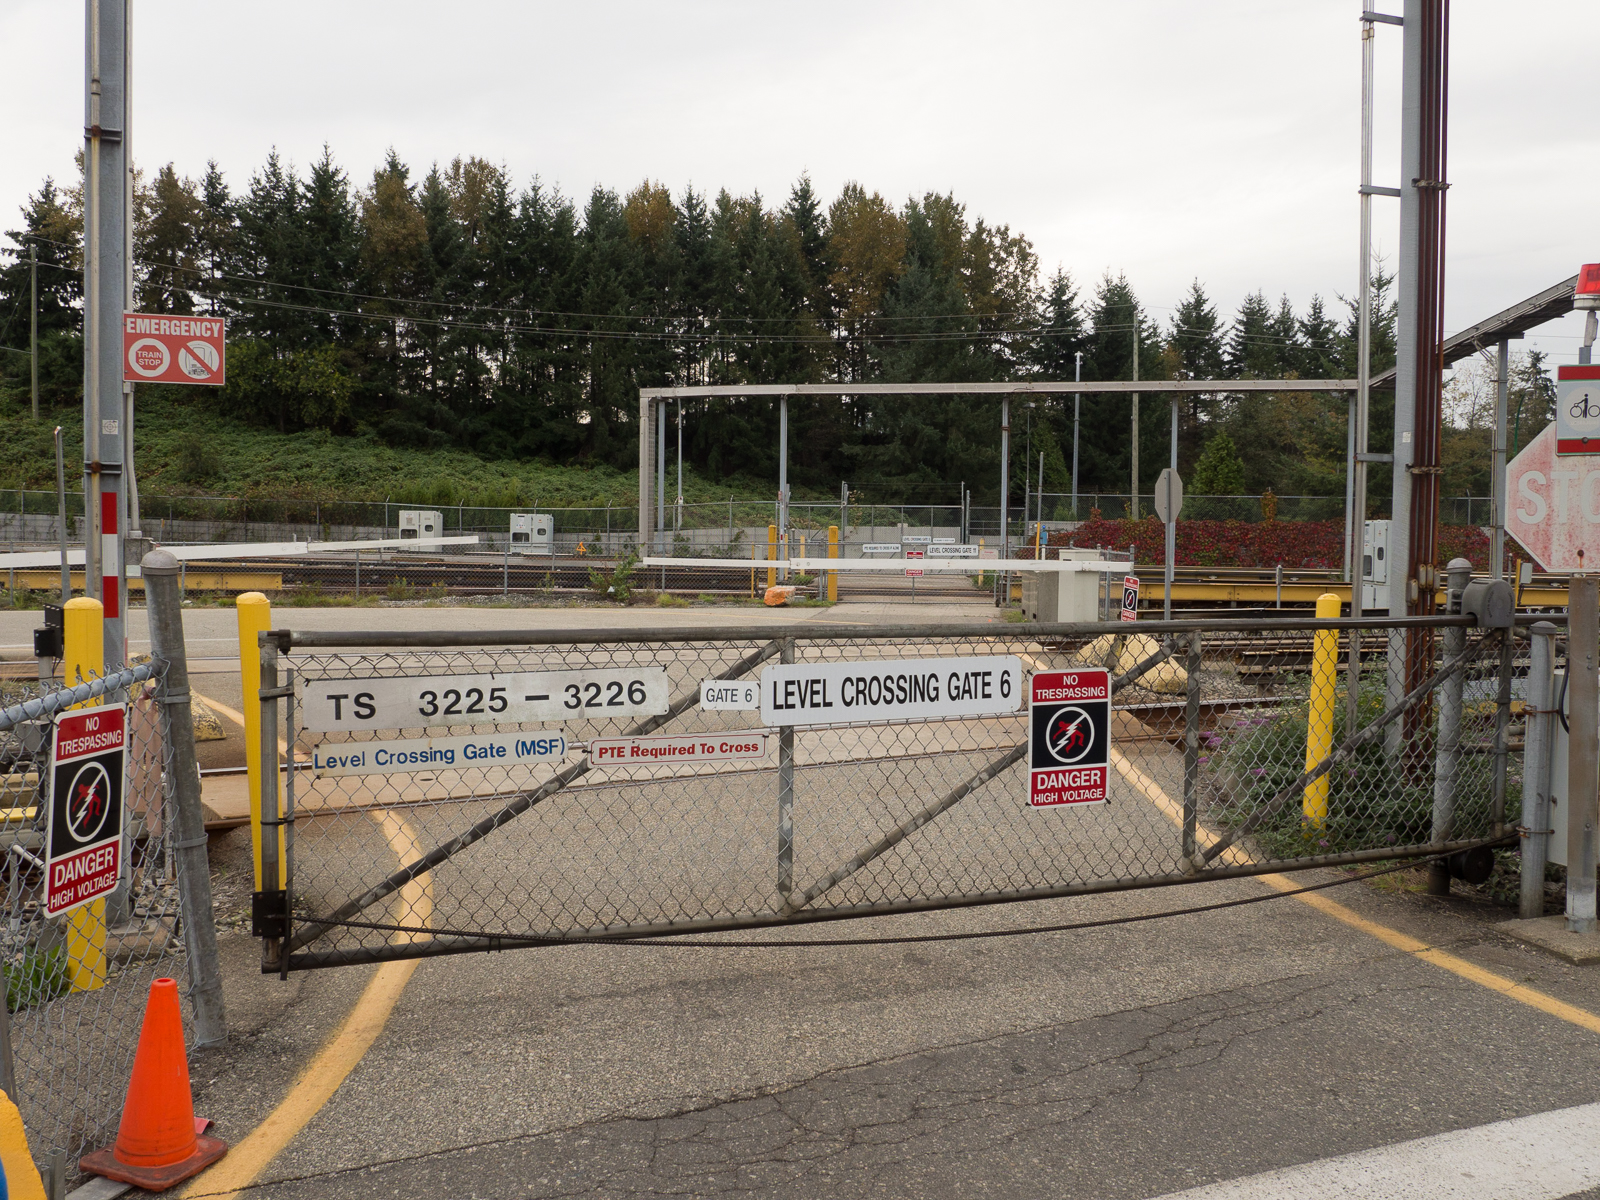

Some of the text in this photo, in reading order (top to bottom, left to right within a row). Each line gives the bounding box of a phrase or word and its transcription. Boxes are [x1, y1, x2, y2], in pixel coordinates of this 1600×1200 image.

[126, 318, 220, 337] EMERGENCY
[773, 669, 1011, 710] LEVEL CROSSING GATE 6
[1063, 675, 1078, 686] NO
[326, 692, 376, 720] TS
[418, 688, 508, 717] 3225
[563, 680, 647, 709] 3226
[706, 688, 753, 703] GATE 6
[1036, 686, 1105, 700] TRESPASSING
[85, 716, 100, 732] NO
[60, 730, 122, 756] TRESPASSING
[598, 742, 759, 760] PTE Required To Cross
[314, 737, 565, 769] Level Crossing Gate (MSF)
[1037, 770, 1101, 790] DANGER
[1034, 788, 1103, 804] HIGH VOLTAGE
[54, 846, 114, 888] DANGER
[50, 871, 116, 909] HIGH VOLTAGE
